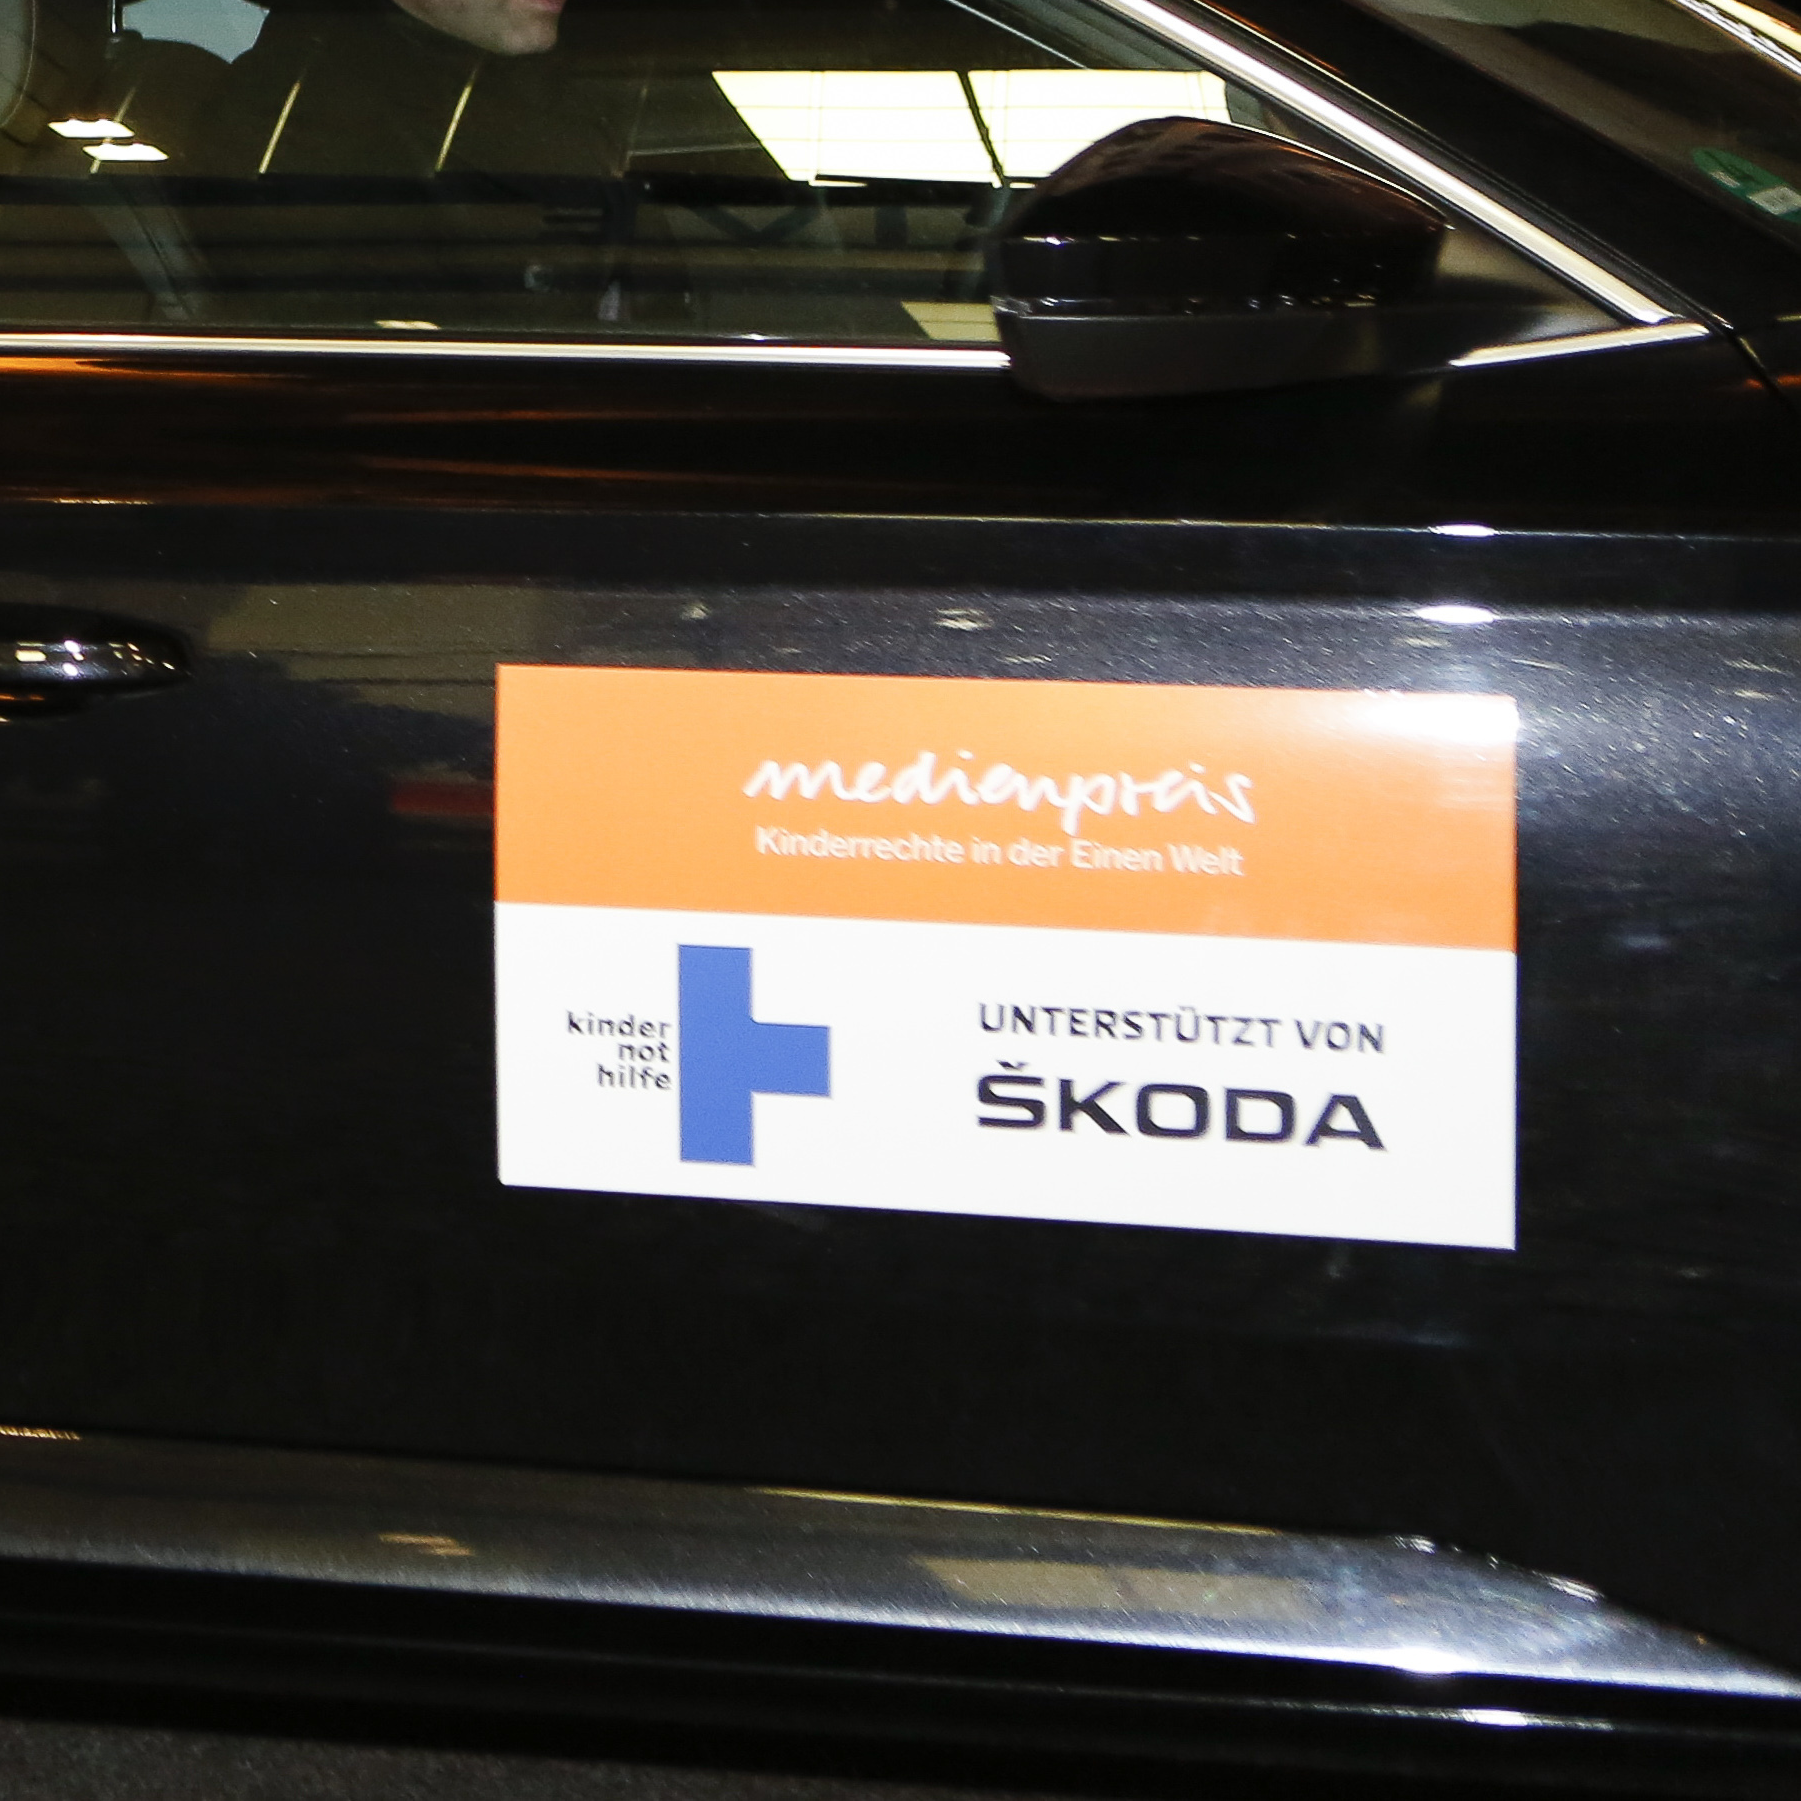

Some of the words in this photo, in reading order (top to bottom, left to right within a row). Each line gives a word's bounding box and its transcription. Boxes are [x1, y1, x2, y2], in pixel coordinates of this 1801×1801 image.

[742, 749, 1256, 837] medienpreis
[754, 825, 965, 865] Kinderrechte
[970, 835, 1002, 865] in
[1006, 836, 1065, 869] der
[1070, 839, 1164, 874] Einen
[1168, 843, 1245, 877] Welt
[566, 1009, 672, 1039] kinder
[978, 1002, 1282, 1049] UNTERSTÜTZT
[1293, 1019, 1386, 1054] VON
[596, 1061, 672, 1091] hilfe
[616, 1041, 671, 1064] not
[975, 1059, 1388, 1152] ŠKODA
